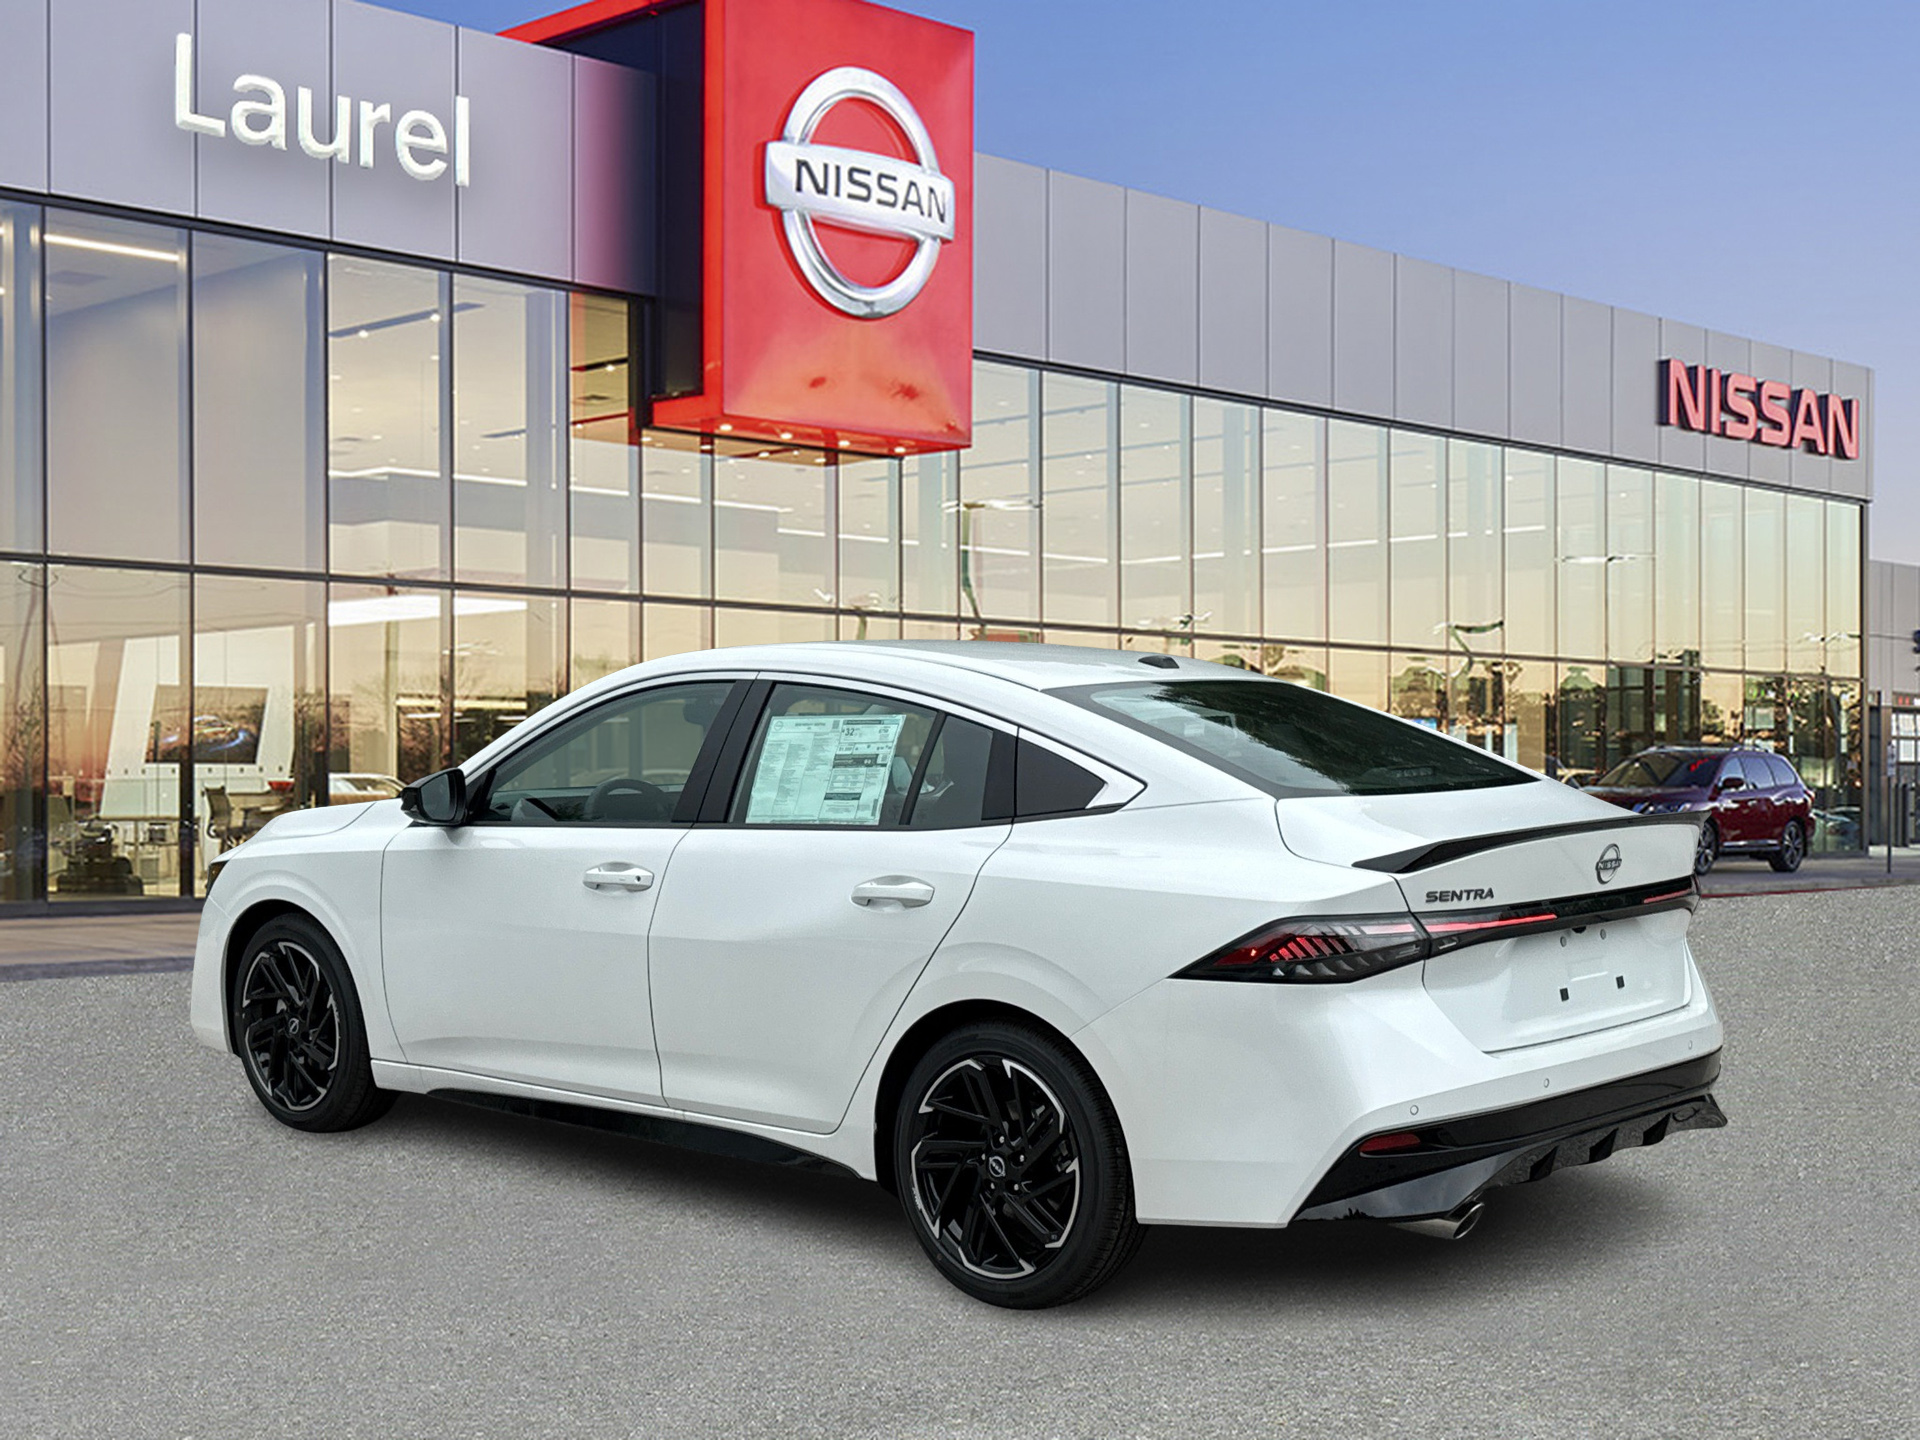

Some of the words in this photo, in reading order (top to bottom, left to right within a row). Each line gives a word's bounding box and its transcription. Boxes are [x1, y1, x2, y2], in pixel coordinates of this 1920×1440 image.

[175, 32, 470, 188] Laurel
[795, 158, 947, 224] NISSAN
[1658, 358, 1860, 460] NISSAN
[1425, 887, 1494, 903] SENTRA
